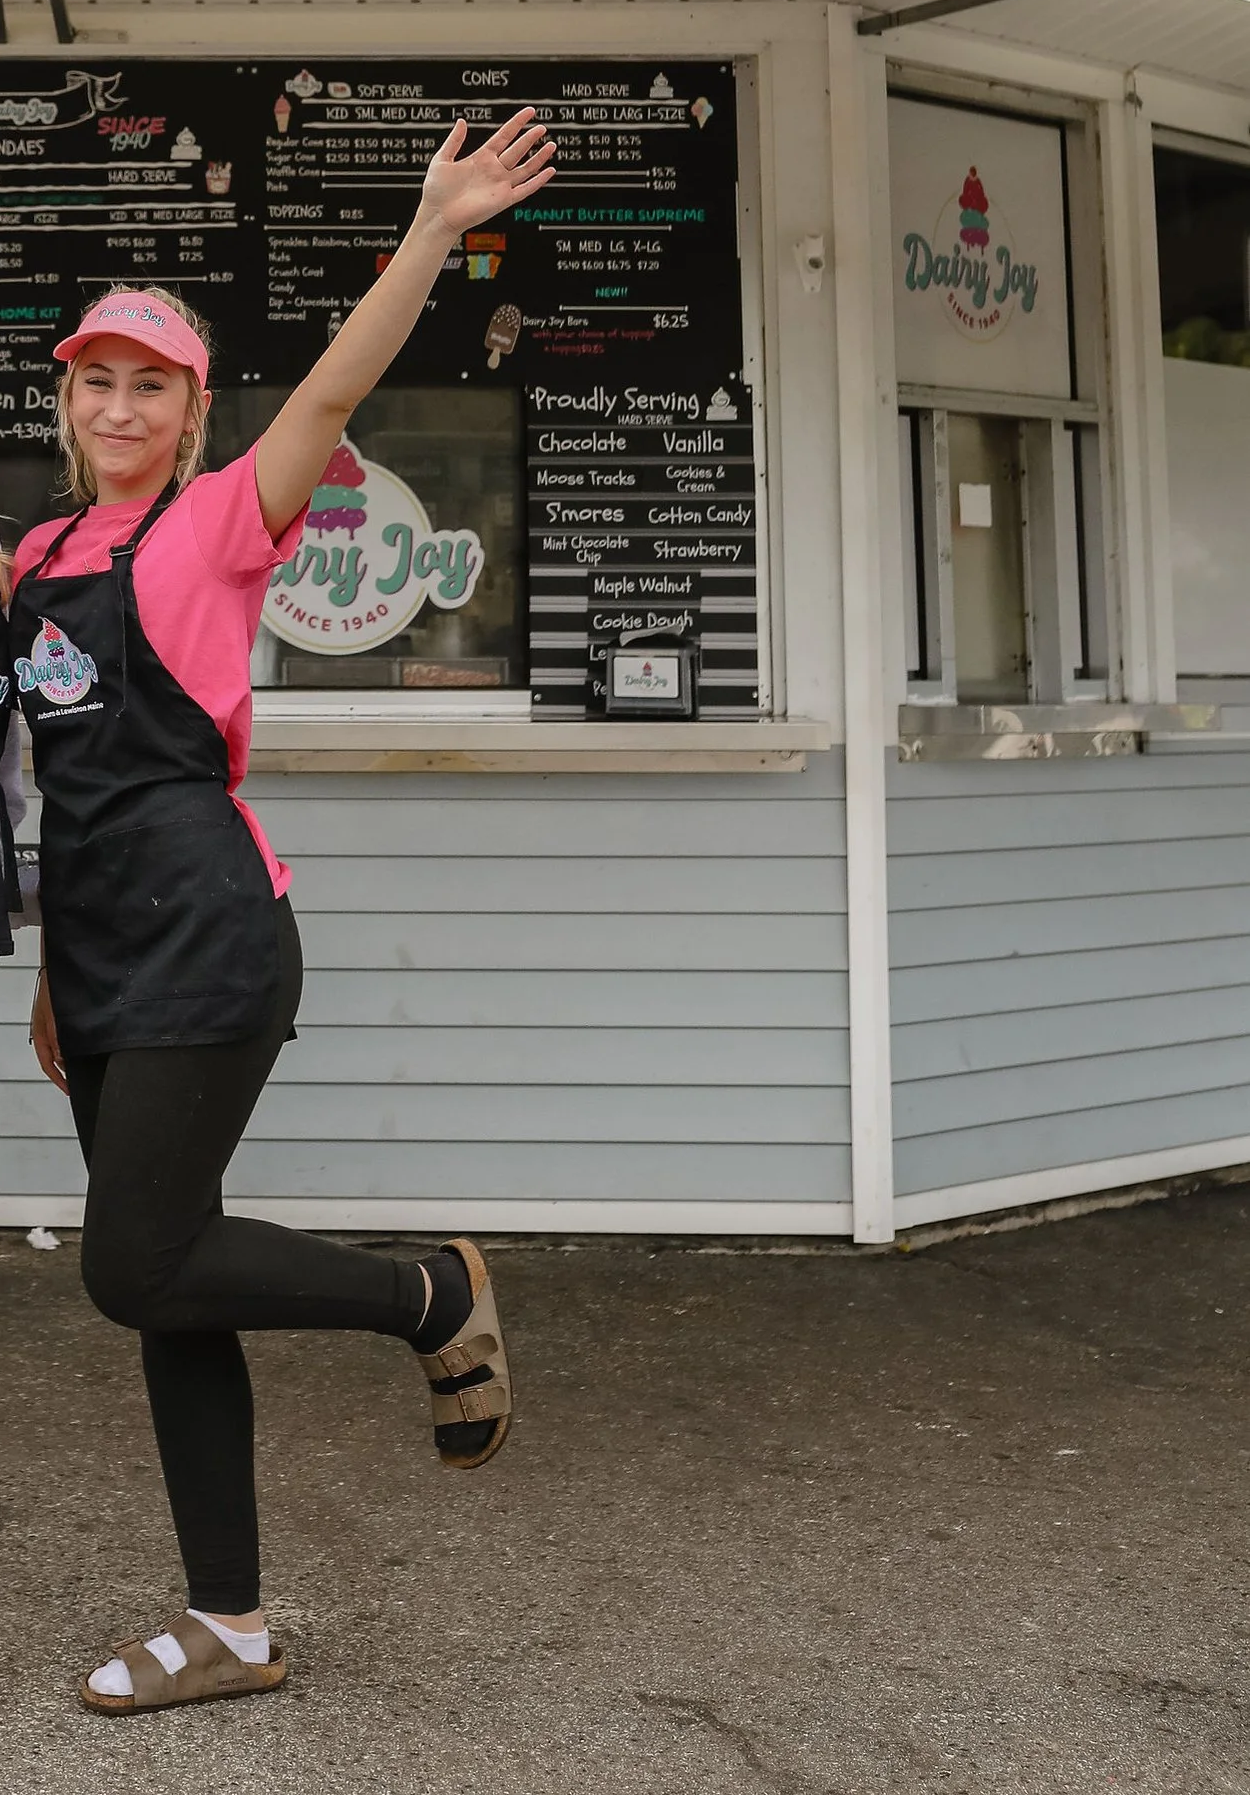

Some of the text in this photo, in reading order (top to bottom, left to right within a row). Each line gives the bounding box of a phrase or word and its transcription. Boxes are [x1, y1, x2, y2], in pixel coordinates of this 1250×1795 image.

[461, 70, 510, 87] CONES
[357, 84, 385, 98] SOFT
[388, 84, 424, 98] SERVE
[562, 84, 630, 97] HARD SERVE
[326, 107, 441, 120] KID SML MED LARG
[559, 108, 643, 121] SM MED LARG
[97, 115, 166, 135] SINCE
[109, 132, 152, 152] 1940
[556, 135, 582, 146] $4.25
[617, 135, 642, 146] $5.75
[556, 150, 582, 161] $4.25
[617, 150, 642, 161] $5.75
[108, 170, 177, 183] HARD SERVE
[651, 167, 676, 178] $5.75
[652, 181, 677, 191] $6.00
[109, 210, 204, 222] KID MED LARGE
[268, 205, 324, 219] TOPPINGS
[514, 209, 705, 222] PEANUT BUTTER SUPREME
[555, 240, 603, 253] SM MED
[607, 259, 631, 271] $6.75
[903, 233, 1039, 314] Dairy Joy
[595, 287, 628, 297] NEW!!
[39, 307, 62, 319] KIT
[97, 305, 167, 327] Dairy Joy
[522, 316, 545, 329] Dairy
[547, 316, 565, 329] Joy
[652, 314, 690, 329] $6.25
[534, 386, 700, 420] Proudly Serving
[617, 414, 673, 425] HARD SERVE
[538, 431, 627, 452] Chocolate
[663, 430, 724, 453] Vanilla
[537, 469, 636, 486] Moose Tracks
[666, 465, 726, 479] Cookies &
[677, 480, 716, 493] Cream
[546, 502, 625, 522] S'mores
[648, 504, 752, 526] Cotton Candy
[543, 535, 629, 550] Mint Chocolate
[653, 539, 742, 562] Strawberry
[375, 523, 477, 601] Joy
[576, 550, 602, 567] Chip
[594, 575, 693, 599] Maple Walnut
[274, 593, 389, 632] SINCE 1940
[593, 609, 694, 634] Cookie Dough
[14, 649, 98, 692] Dairy Joy
